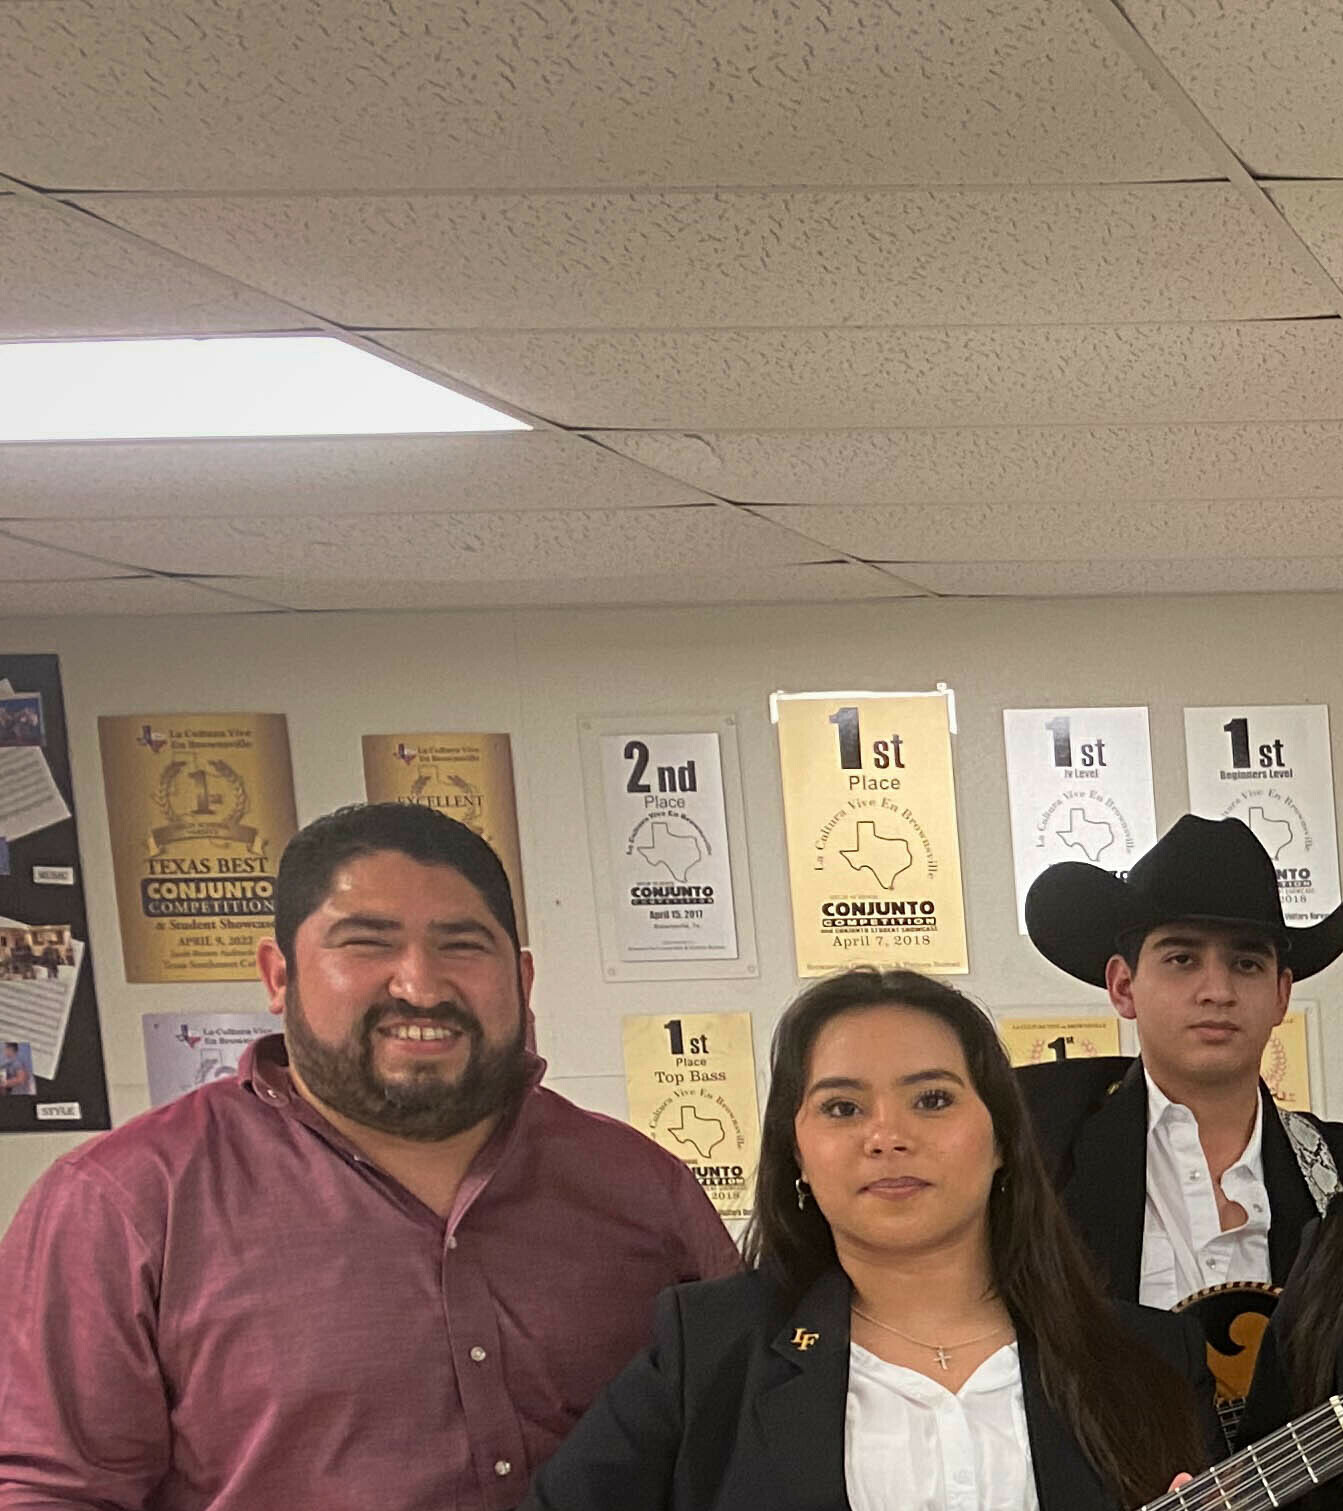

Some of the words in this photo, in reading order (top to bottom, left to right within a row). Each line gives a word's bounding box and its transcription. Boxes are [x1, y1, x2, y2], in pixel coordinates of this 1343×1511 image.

[1075, 769, 1098, 778] Level
[1220, 770, 1267, 780] Beginners
[1269, 768, 1293, 778] Level
[849, 775, 901, 790] Place
[1268, 788, 1282, 800] En
[644, 795, 686, 809] Place
[848, 798, 876, 810] Vive
[881, 797, 898, 812] En
[815, 809, 847, 850] Cultura
[902, 808, 938, 879] Brownsville
[146, 858, 210, 874] TEXAS
[217, 857, 268, 874] BEST
[814, 856, 824, 871] La
[147, 880, 273, 899] CONJUNTO
[631, 886, 714, 898] CONJUNTO
[148, 900, 275, 914] COMPETITION
[822, 901, 934, 916] CONJUNTO
[649, 910, 670, 920] April
[684, 909, 703, 919] 2017
[170, 919, 217, 930] Student
[823, 917, 936, 927] COMPETITION
[178, 936, 211, 945] APRIL
[832, 935, 870, 949] April
[876, 936, 889, 948] 7,
[894, 934, 931, 946] 2018
[676, 1057, 707, 1067] Place
[654, 1071, 684, 1085] Top
[690, 1070, 726, 1082] Bass
[791, 1328, 820, 1351] LF
